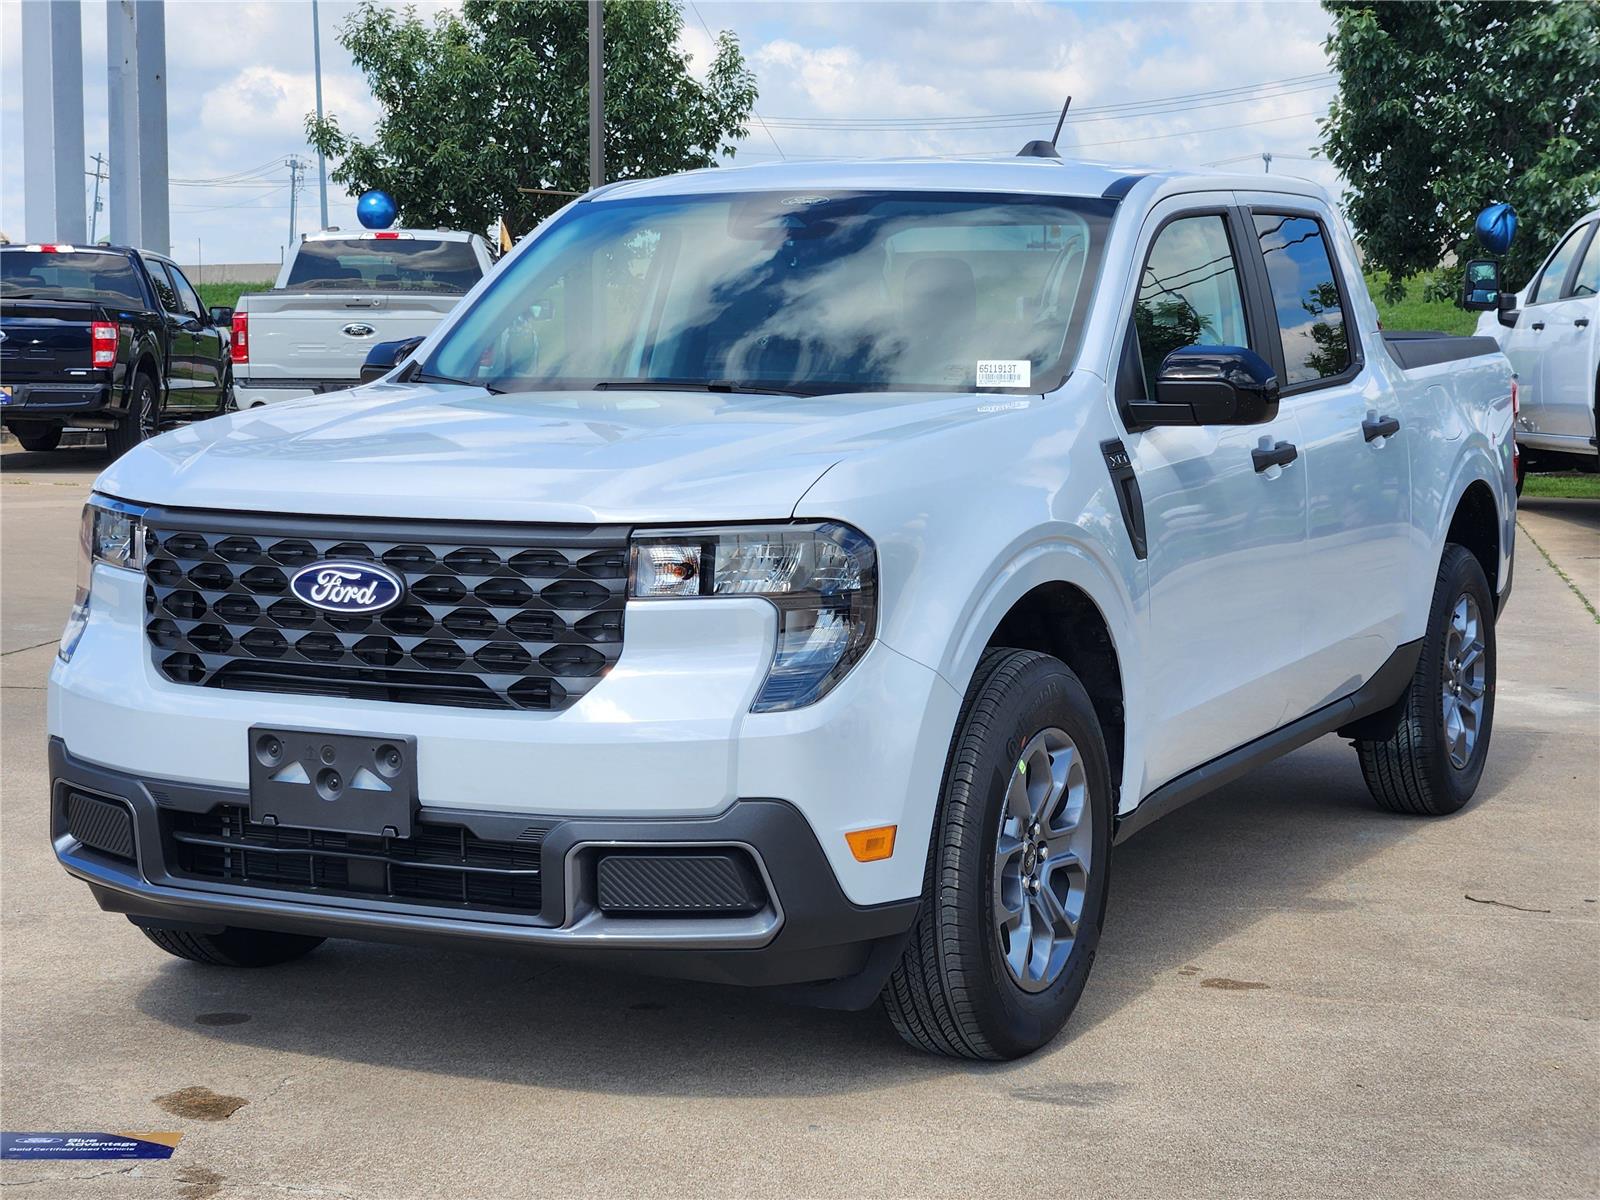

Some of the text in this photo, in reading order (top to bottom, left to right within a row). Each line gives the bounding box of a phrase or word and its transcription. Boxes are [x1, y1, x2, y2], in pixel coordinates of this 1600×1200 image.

[350, 326, 368, 335] Ford
[979, 364, 1017, 373] 6511913T
[311, 569, 378, 605] Ford
